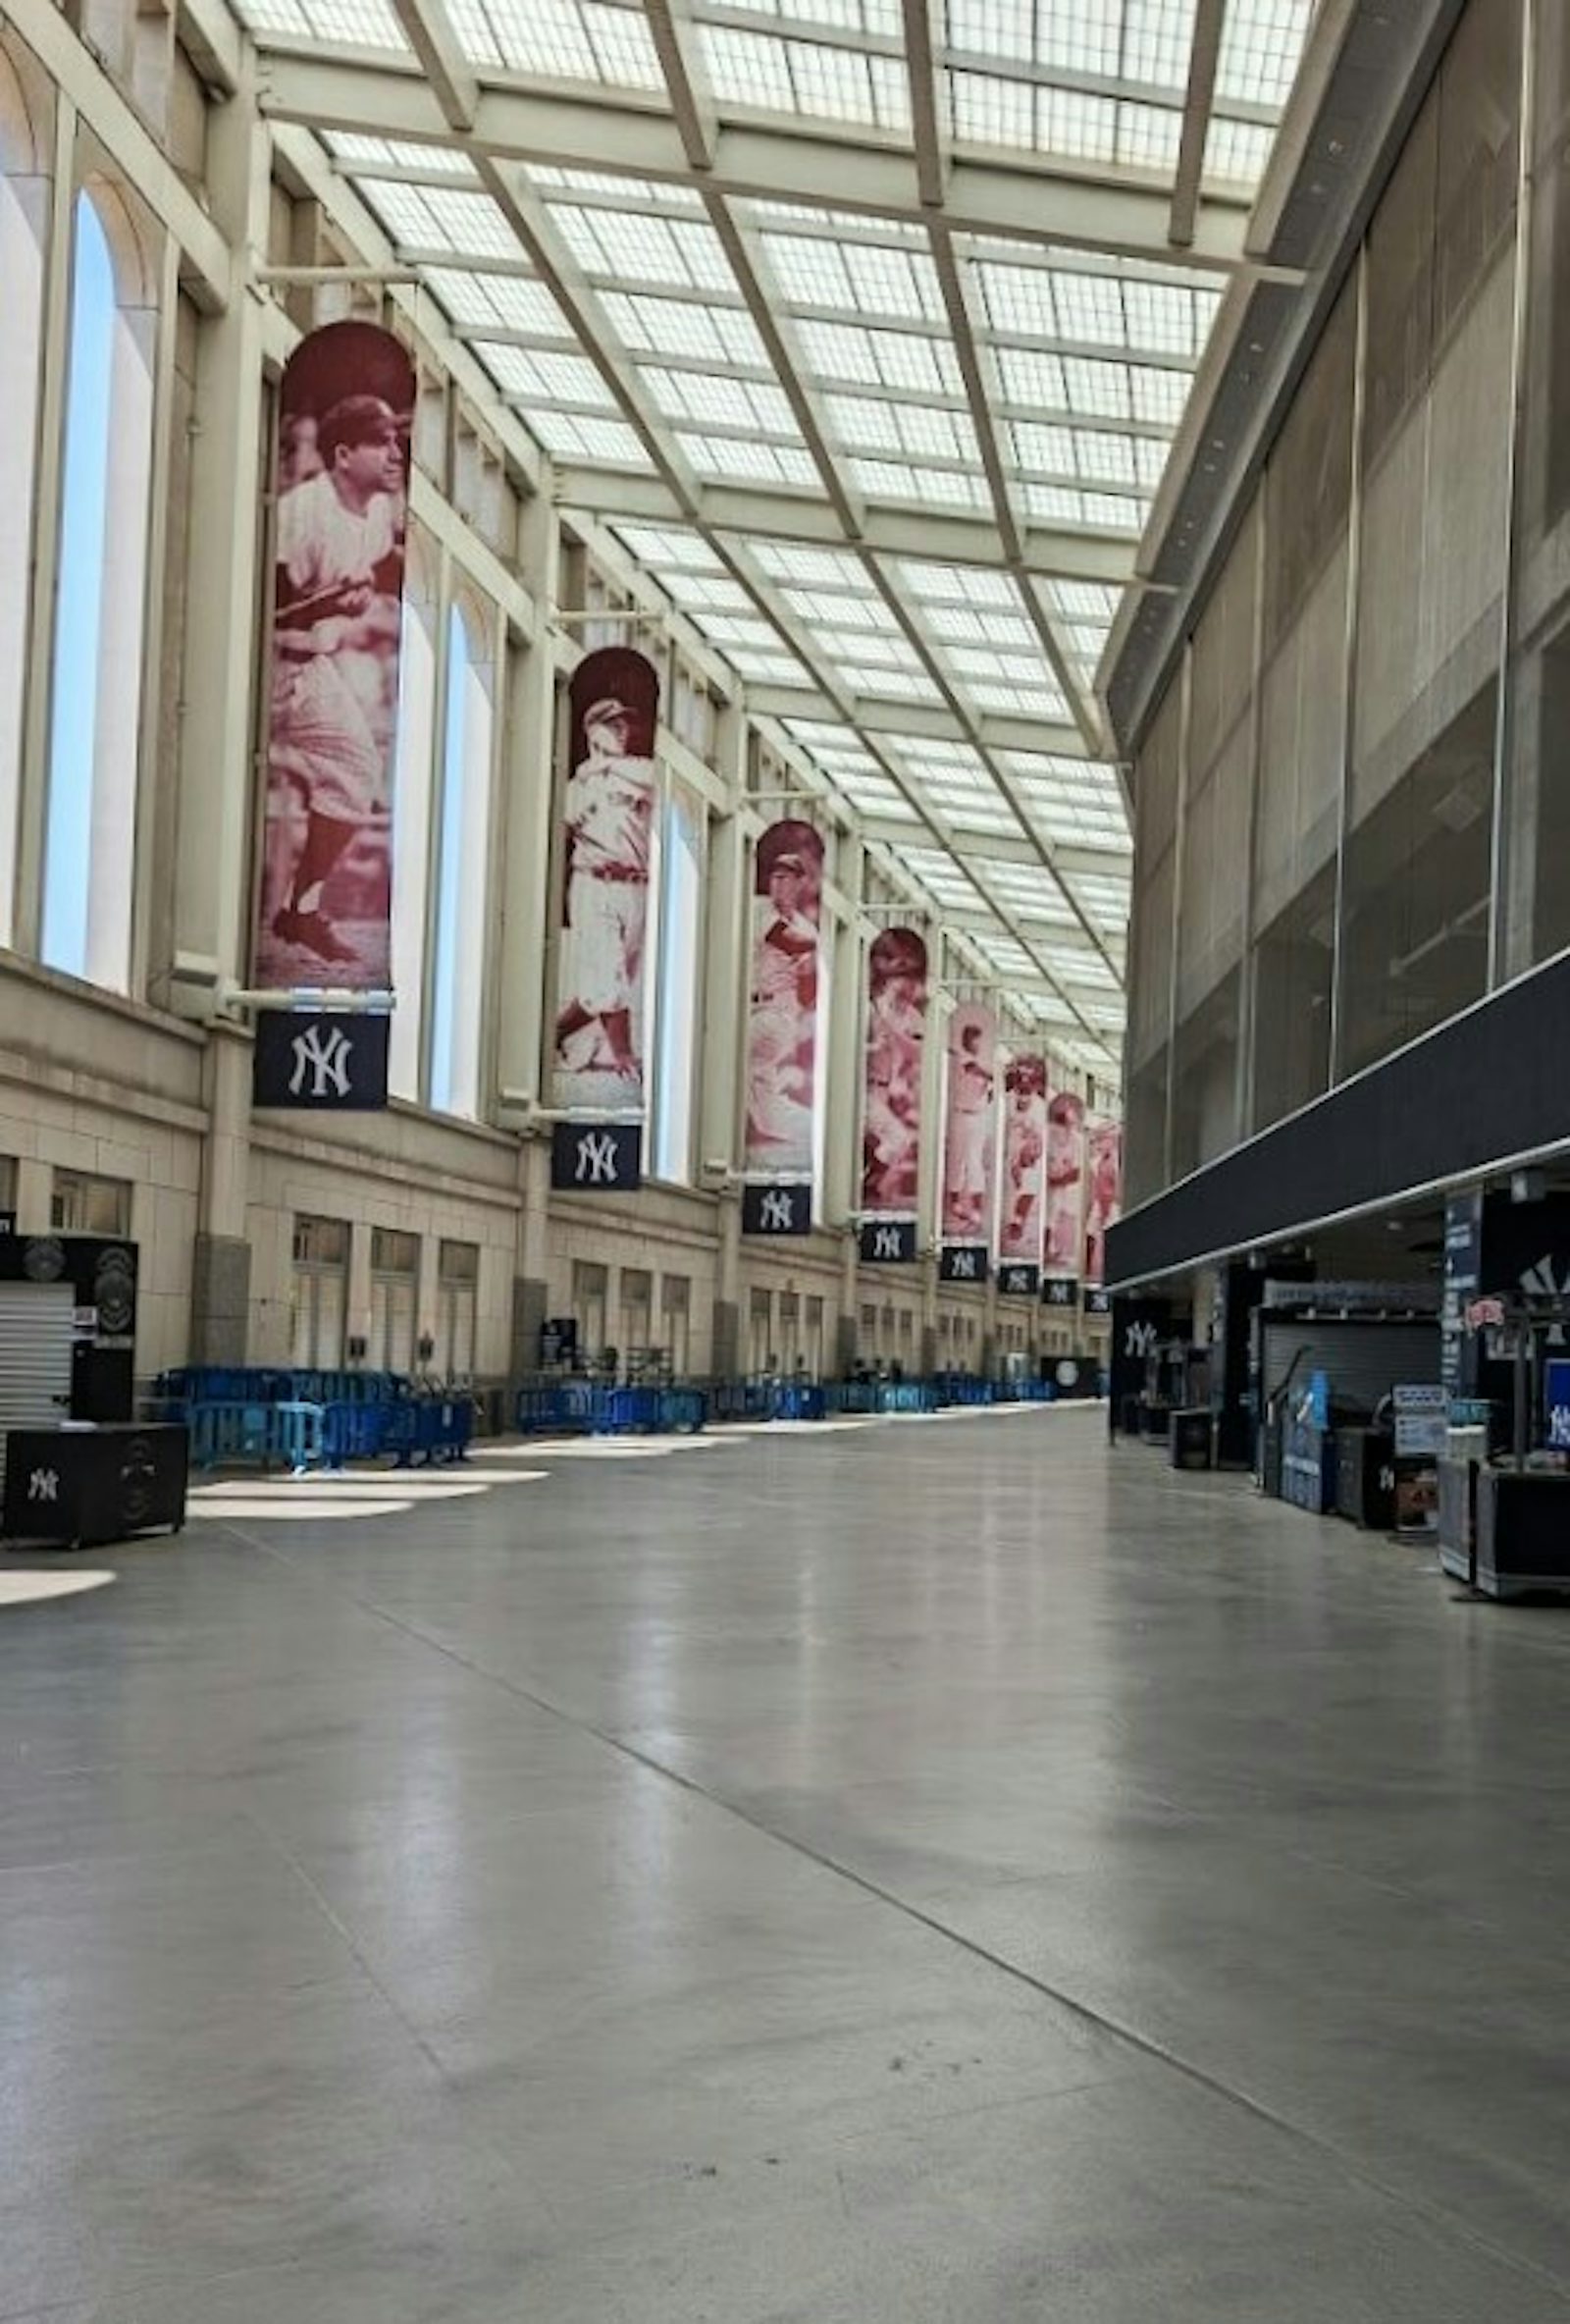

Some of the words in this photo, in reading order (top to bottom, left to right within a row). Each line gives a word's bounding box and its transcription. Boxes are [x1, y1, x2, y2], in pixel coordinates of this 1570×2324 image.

[288, 1024, 353, 1097] NY
[575, 1131, 618, 1182] NY
[759, 1189, 793, 1230] NY
